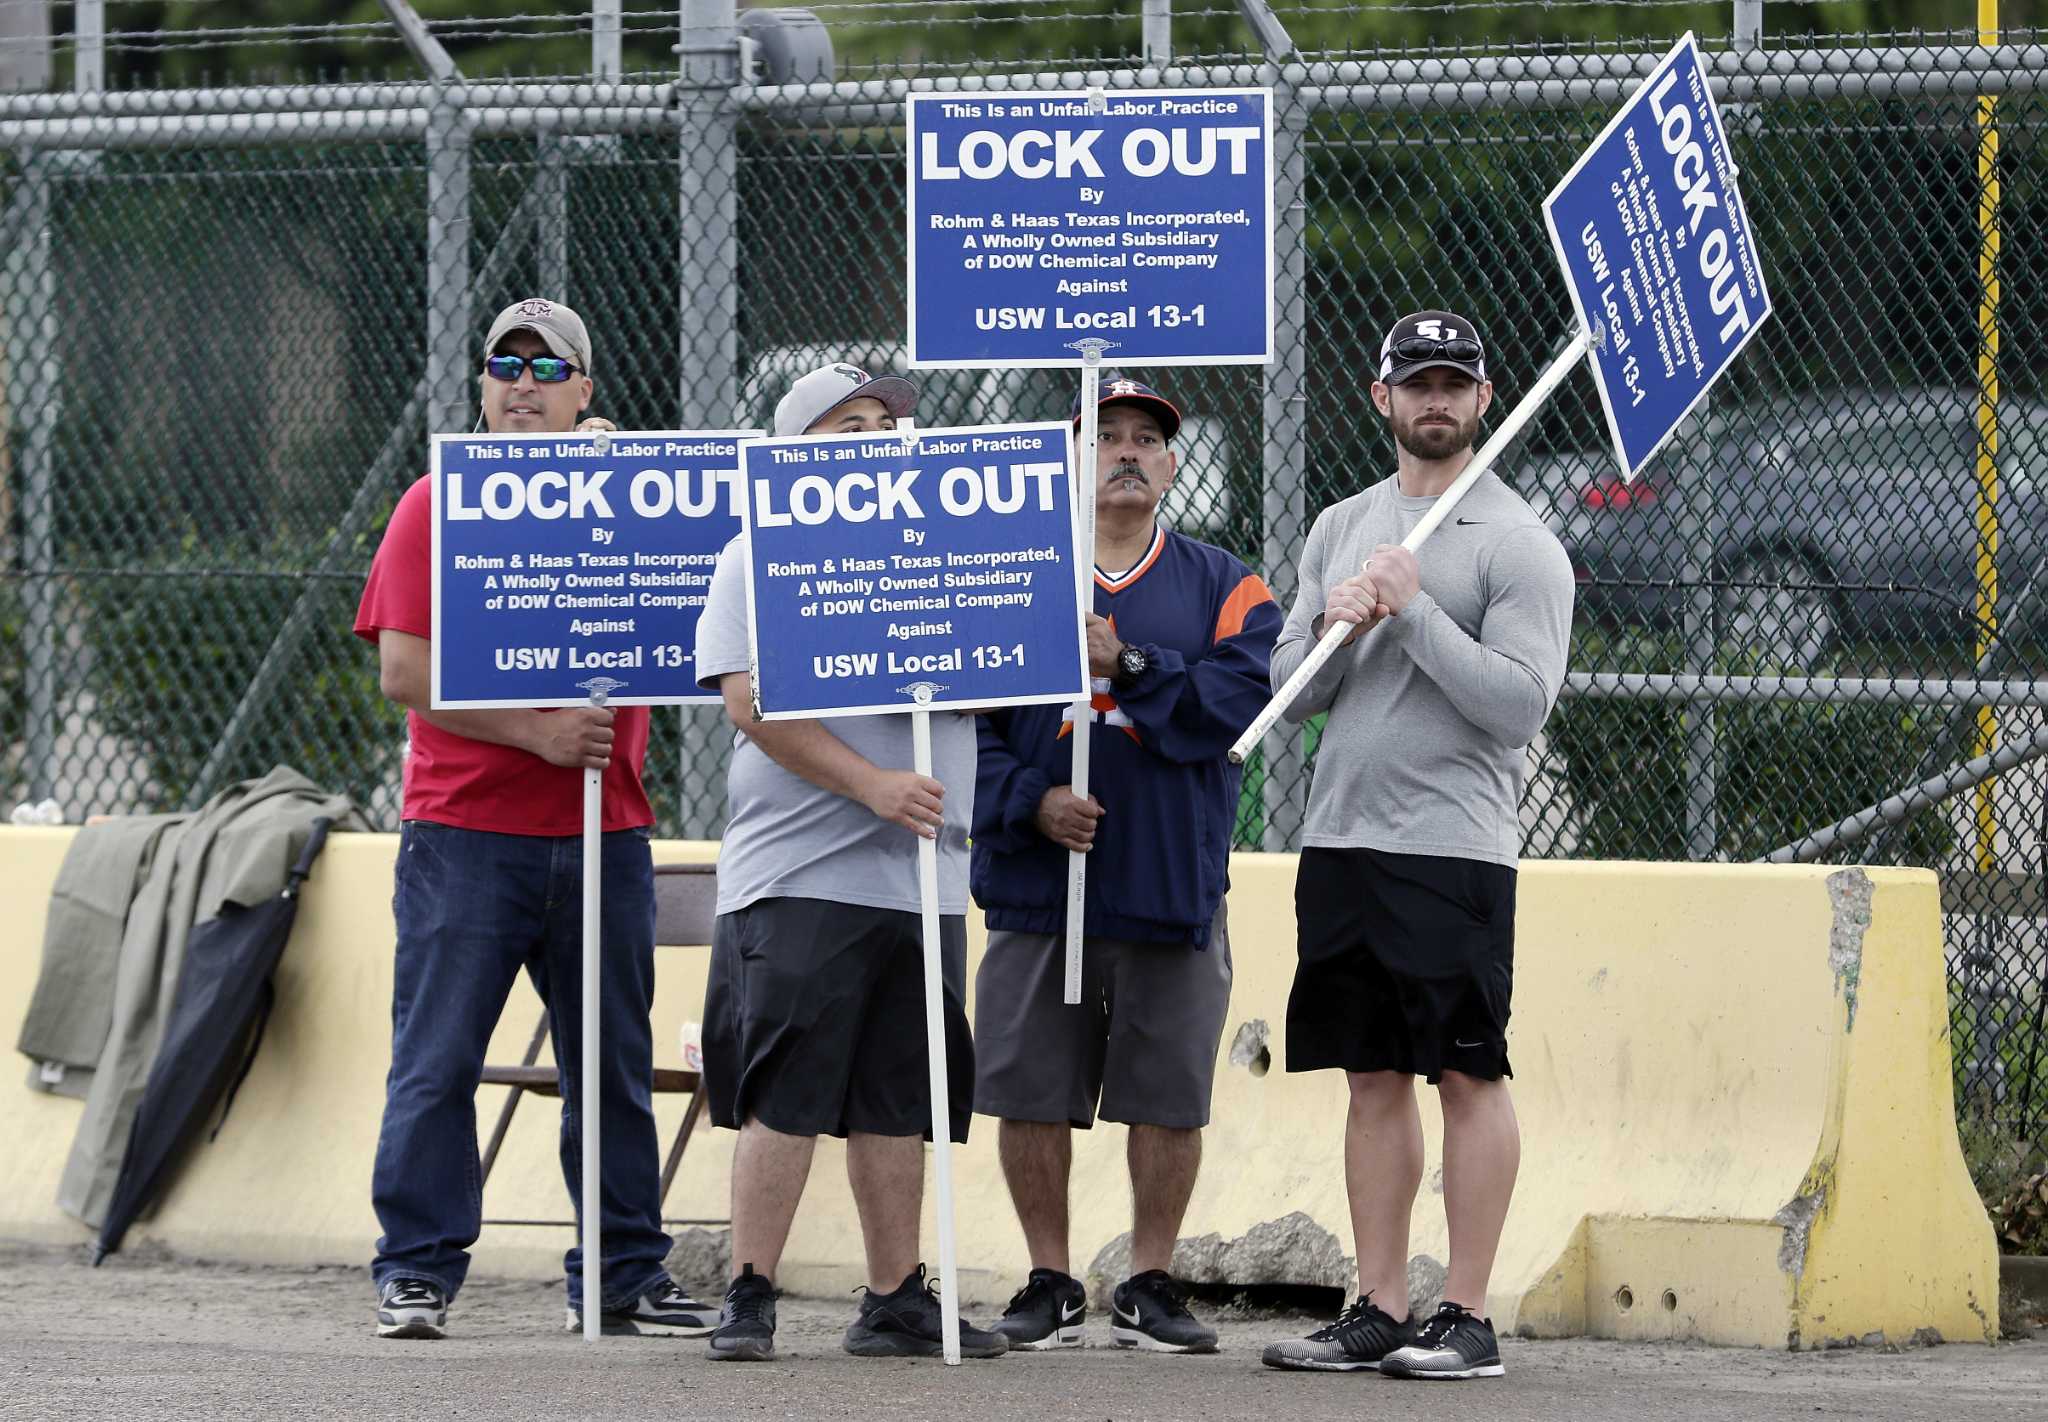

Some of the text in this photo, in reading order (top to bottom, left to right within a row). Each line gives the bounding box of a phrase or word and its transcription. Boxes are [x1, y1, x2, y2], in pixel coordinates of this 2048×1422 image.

[941, 104, 981, 117] This
[988, 104, 1005, 117] Is
[1010, 106, 1033, 117] an
[1103, 101, 1155, 116] Labor
[1161, 100, 1238, 115] Practice
[922, 127, 1260, 180] LOCK OUT
[1688, 66, 1701, 102] This
[1698, 102, 1707, 120] Is
[1704, 122, 1714, 142] an
[1725, 190, 1740, 233] Labor
[1736, 234, 1757, 297] Practice
[1080, 188, 1104, 204] By
[1649, 69, 1750, 344] LOCK OUT
[931, 209, 1250, 228] Rohm & Haas Texas Incorporated,
[963, 231, 1219, 251] A Wholly Owned Subsidiary
[1676, 226, 1686, 248] By
[965, 253, 1218, 269] of DOW Chemical Company
[1625, 127, 1704, 378] Rohm & Haas Texas Incorporated,
[1622, 168, 1686, 365] A Wholly Owned Subsidiary
[1057, 279, 1127, 296] Against
[1612, 182, 1675, 377] of DOW Chemical Company
[1621, 268, 1643, 325] Against
[976, 305, 1204, 330] USW Local 13-1
[1582, 221, 1610, 282] USW
[1602, 283, 1630, 354] Local
[1623, 356, 1645, 406] 13-1
[465, 442, 735, 458] This Is an Unfa Labor Practice
[771, 436, 1042, 463] This Is an Unfair Labor Practice
[447, 469, 741, 520] LOCK OUT
[755, 470, 925, 527] LOCK
[939, 462, 1064, 516] OUT
[592, 528, 614, 544] By
[903, 529, 925, 546] By
[455, 555, 504, 569] Rohm
[510, 554, 523, 568] &
[530, 554, 573, 567] Haas
[578, 553, 629, 566] Texas
[768, 546, 1059, 576] Rohm & Haas Texas Incorporated,
[484, 576, 498, 589] A
[502, 574, 560, 591] Wholly
[565, 573, 624, 587] Owned
[799, 570, 1032, 596] A Wholly Owned Subsidiary
[486, 593, 708, 609] of DOW Chemical Compan
[801, 593, 1032, 616] of DOW Chemical Company
[570, 619, 634, 636] Against
[887, 621, 952, 640] Against
[496, 648, 560, 670] USW
[569, 646, 642, 668] Local
[814, 644, 1024, 678] USW Local 13-1
